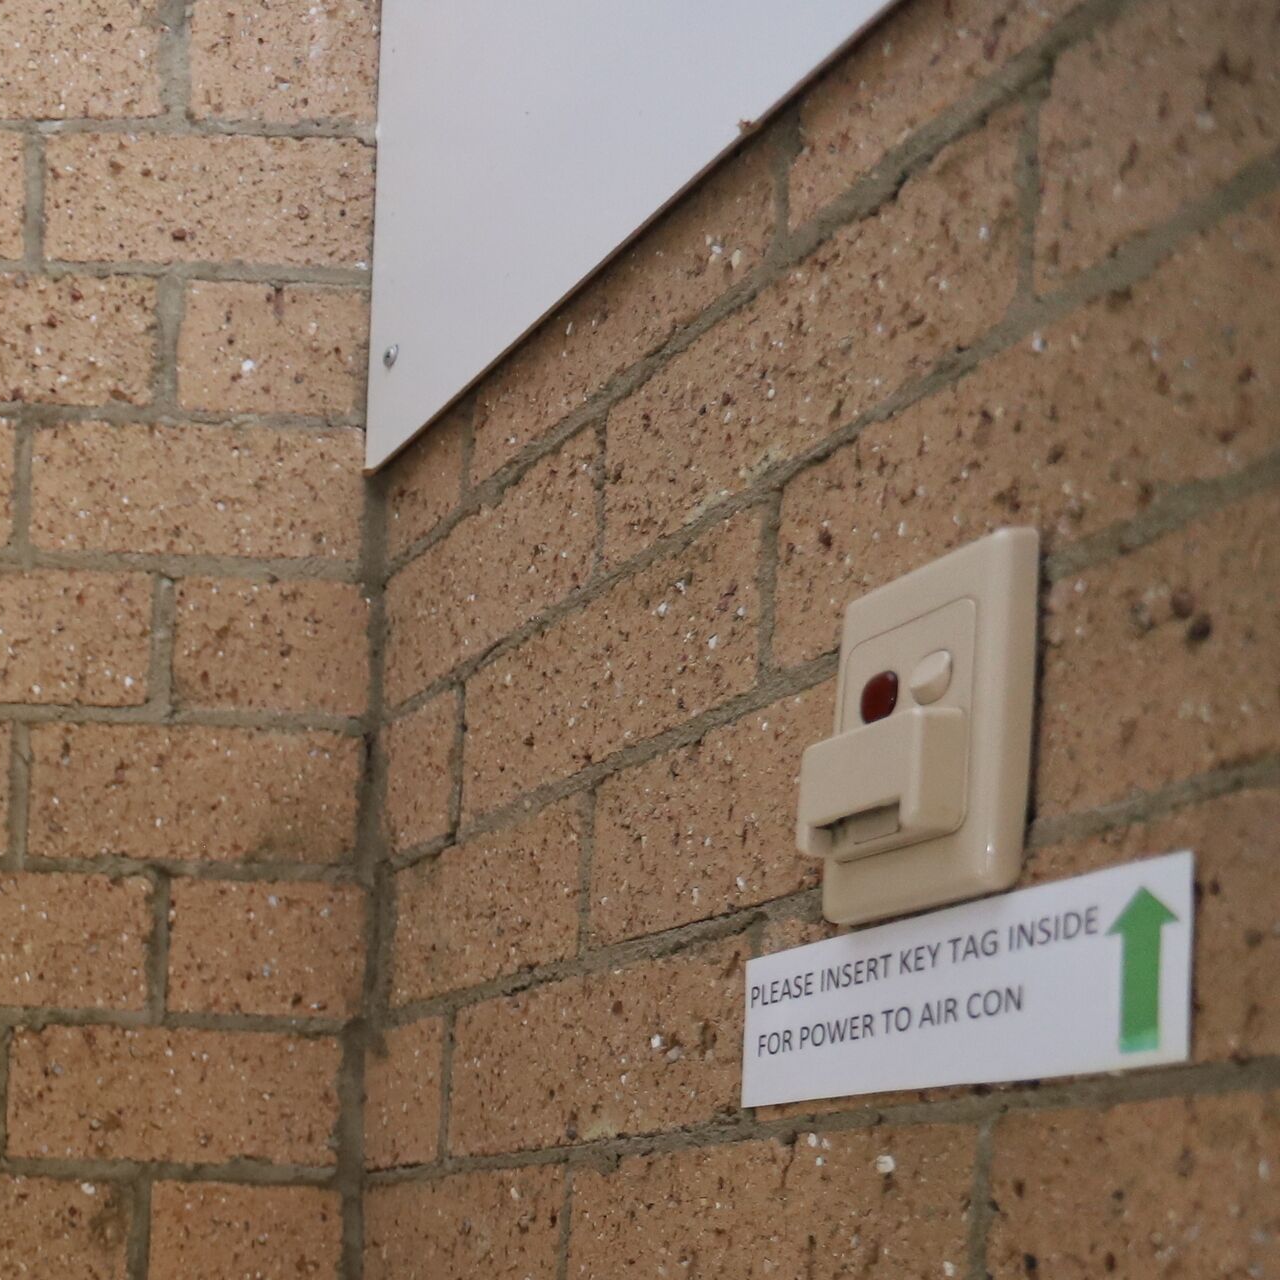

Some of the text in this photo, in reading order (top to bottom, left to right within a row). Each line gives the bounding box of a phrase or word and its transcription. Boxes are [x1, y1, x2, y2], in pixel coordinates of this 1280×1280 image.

[750, 906, 1101, 1009] PLEASE INSERT KEY TAG INSIDE
[757, 984, 1026, 1057] FOR POWER TO AIR CON
